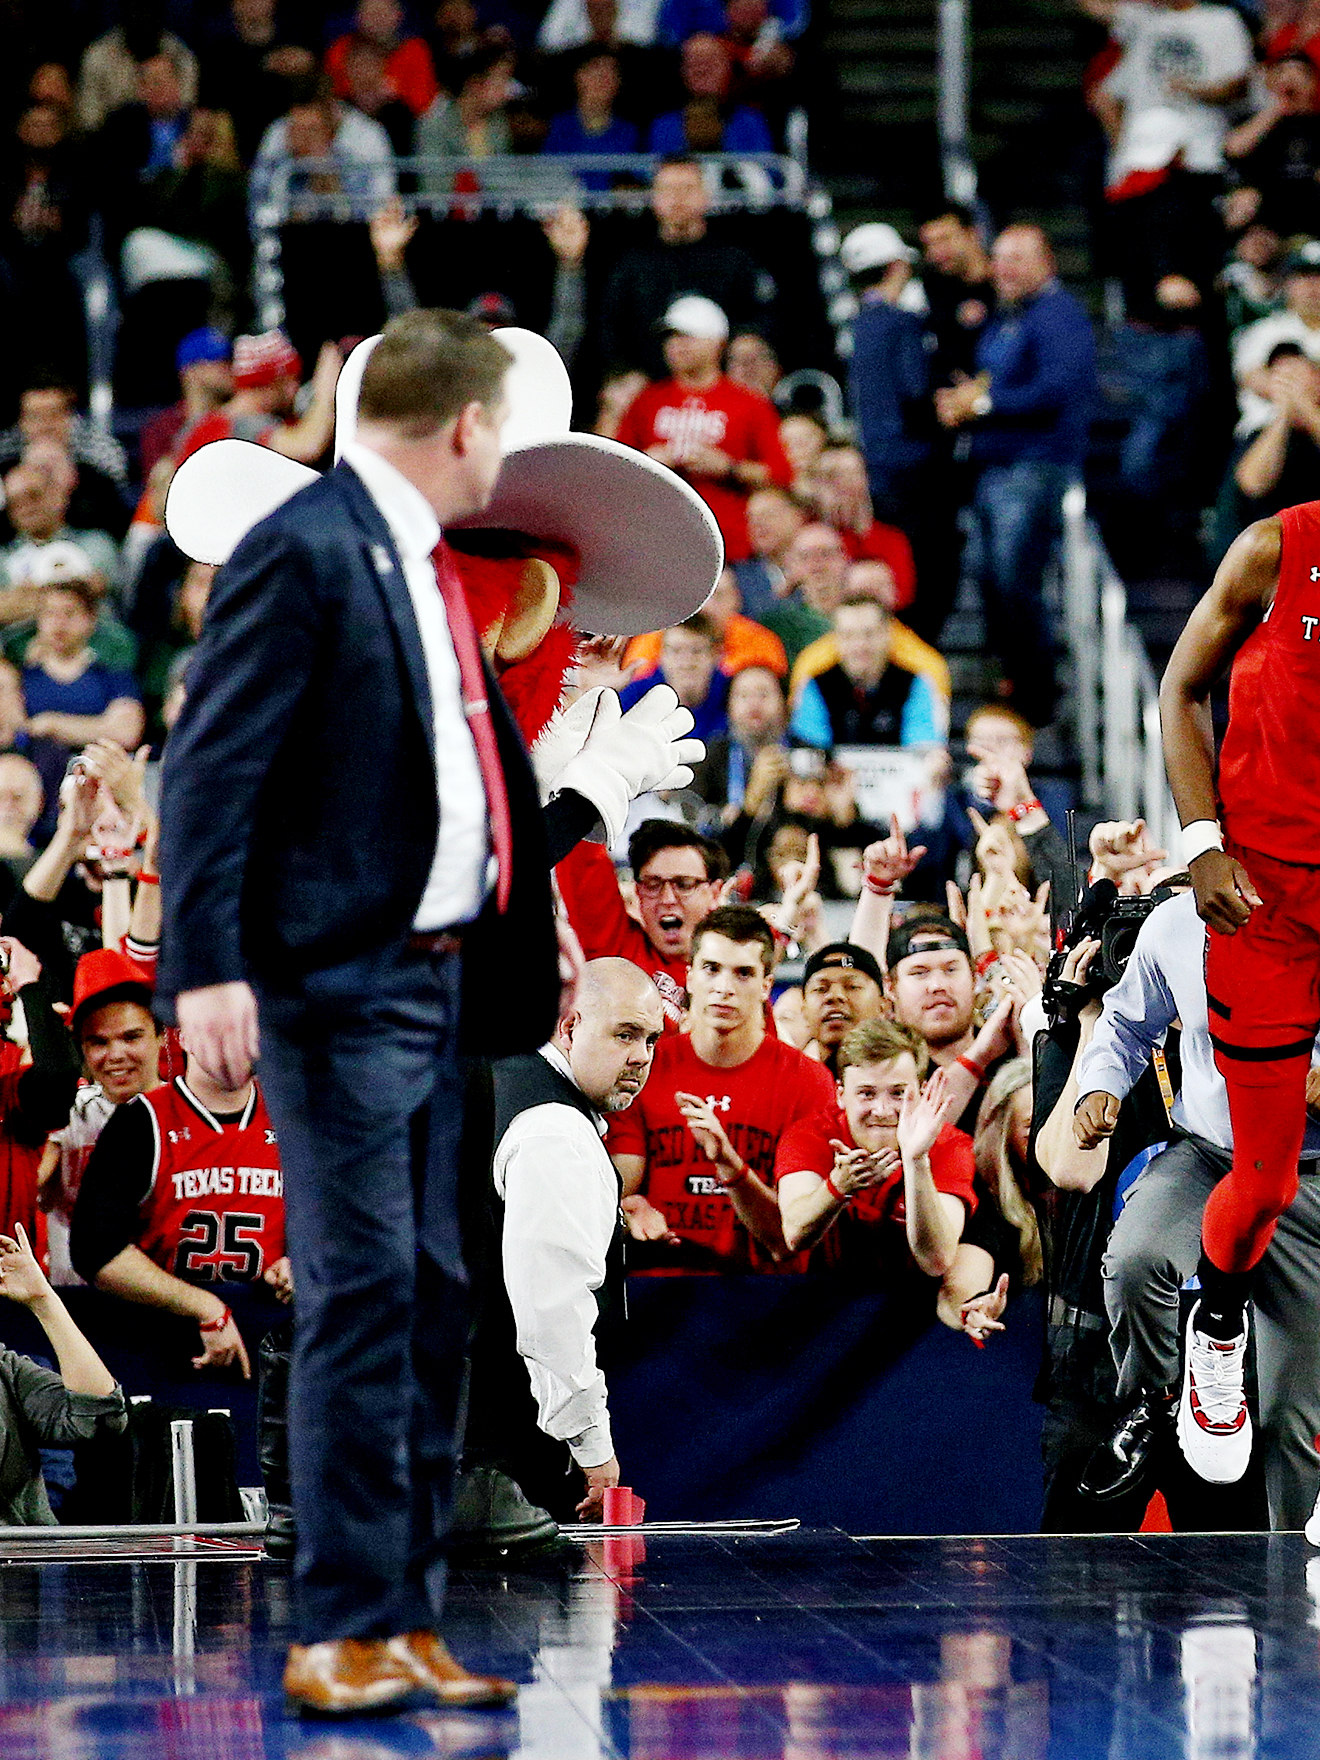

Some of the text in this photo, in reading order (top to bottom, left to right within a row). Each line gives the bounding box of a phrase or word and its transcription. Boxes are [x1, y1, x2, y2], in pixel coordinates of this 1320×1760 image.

[171, 1167, 284, 1200] TEXAS TECH
[174, 1209, 266, 1281] 25
